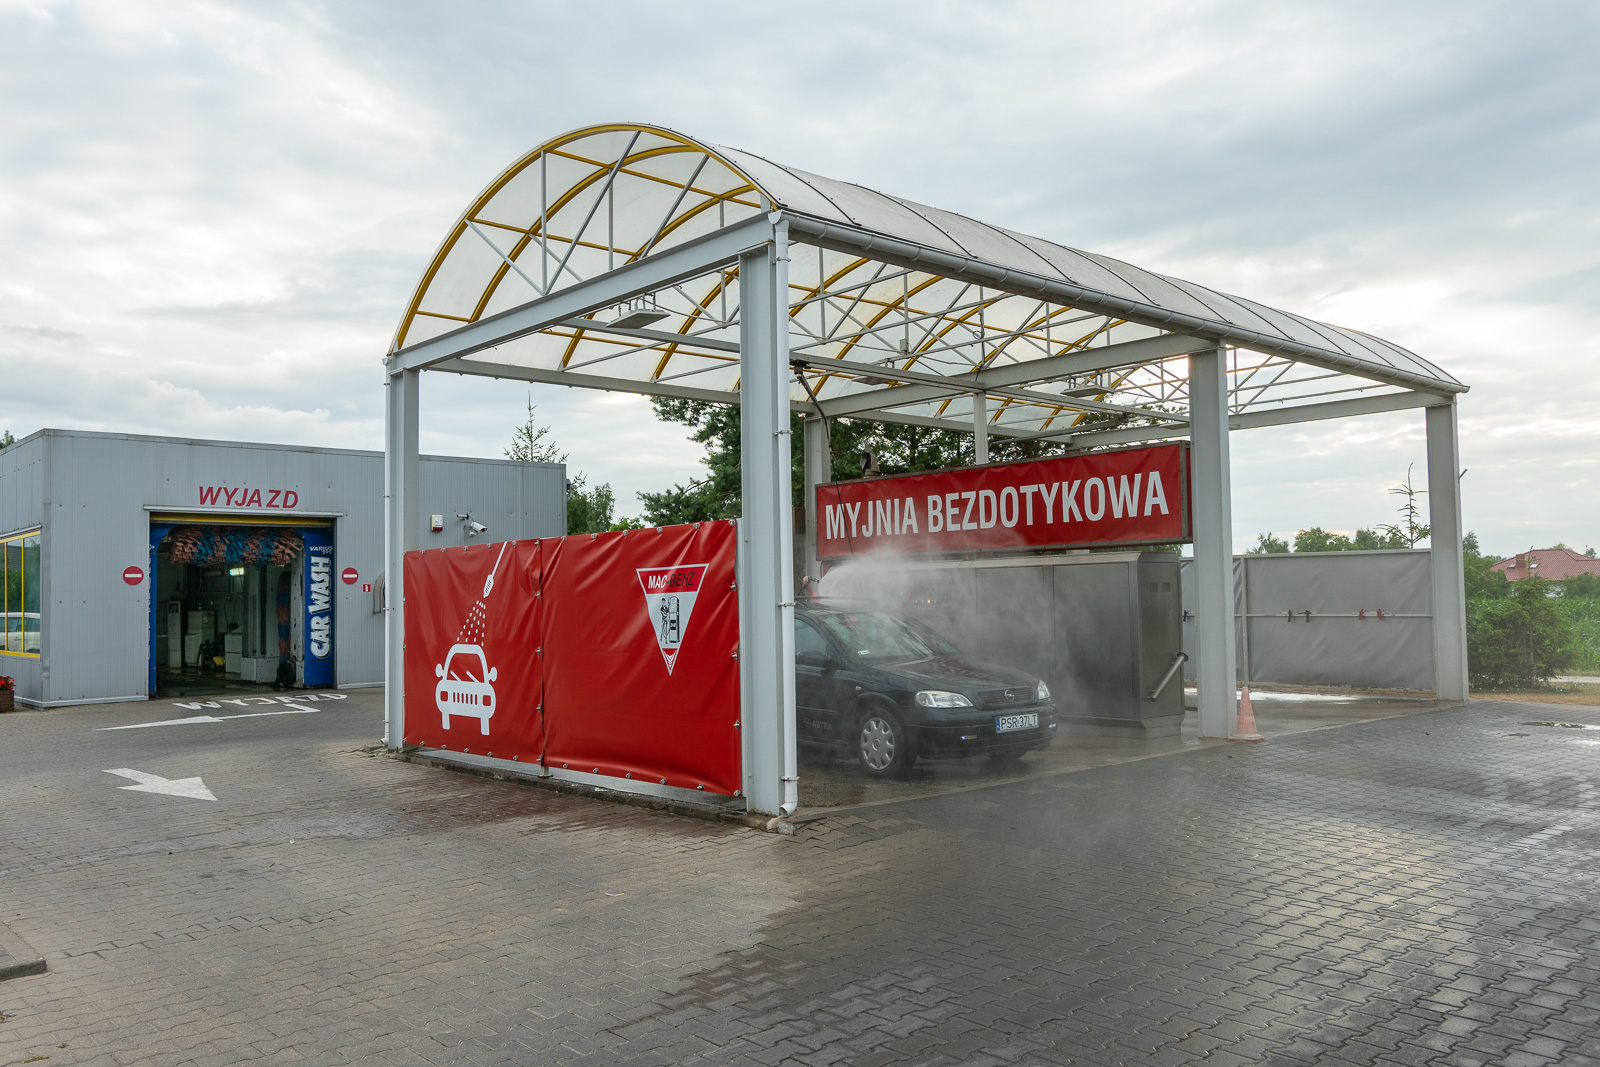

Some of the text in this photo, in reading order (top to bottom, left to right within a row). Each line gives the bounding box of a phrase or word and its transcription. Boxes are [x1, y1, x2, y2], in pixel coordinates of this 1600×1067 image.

[198, 486, 299, 509] WYJAZD
[825, 470, 1170, 540] MYJNIA BEZDOTYKOWA
[308, 556, 332, 614] WASH
[647, 572, 696, 589] MAC-BENZ
[310, 615, 332, 659] CAR
[812, 720, 832, 731] ASTRA
[1001, 714, 1037, 729] PSR 37LT
